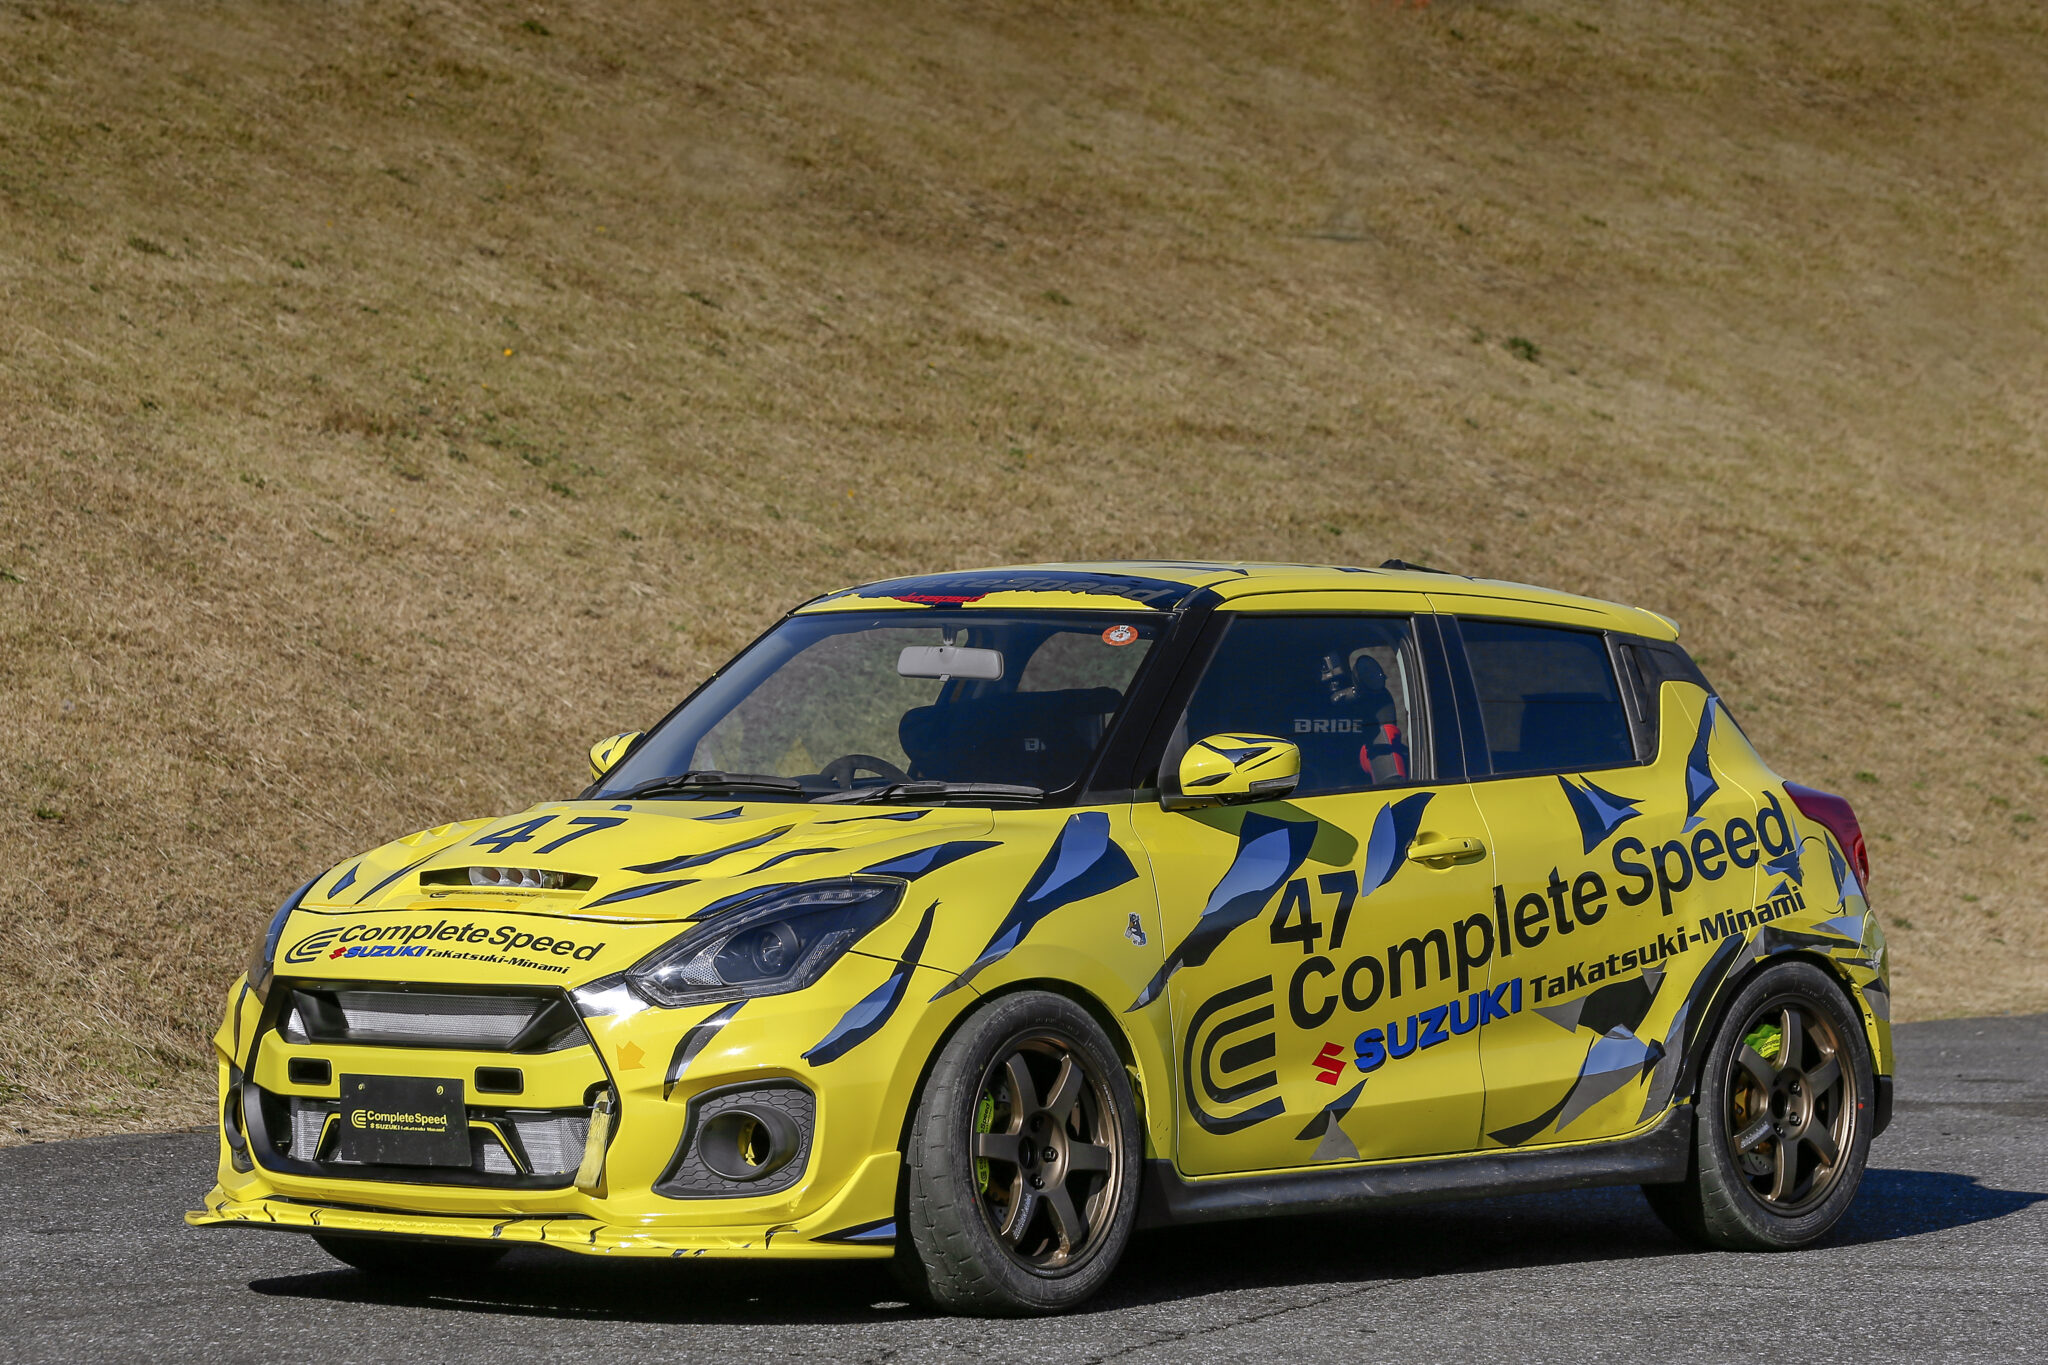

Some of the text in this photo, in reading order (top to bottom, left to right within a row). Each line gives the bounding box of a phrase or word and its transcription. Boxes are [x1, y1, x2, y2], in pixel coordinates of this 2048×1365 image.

[1293, 718, 1363, 733] BRIDE
[470, 814, 629, 854] 47
[1270, 870, 1358, 955] 47
[343, 945, 427, 959] SUZUKI
[1353, 977, 1522, 1074] SUZUKI
[375, 1122, 400, 1131] SUZUKI
